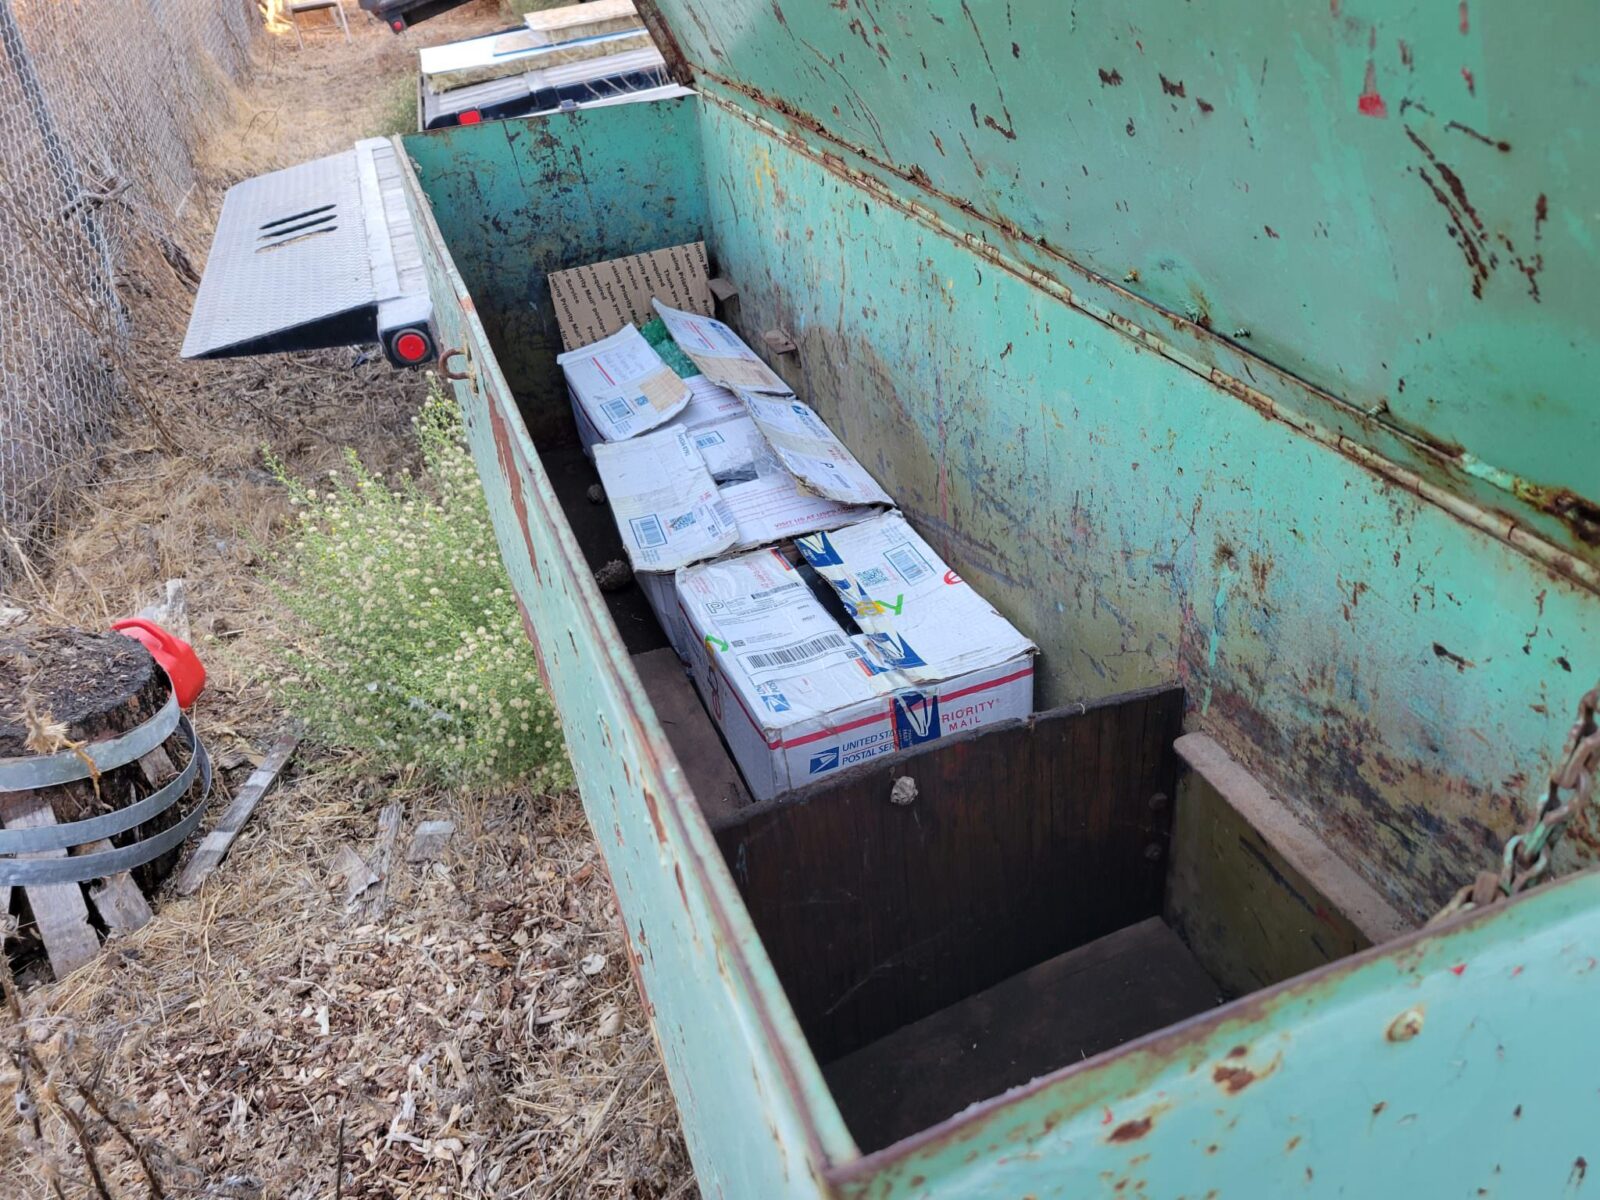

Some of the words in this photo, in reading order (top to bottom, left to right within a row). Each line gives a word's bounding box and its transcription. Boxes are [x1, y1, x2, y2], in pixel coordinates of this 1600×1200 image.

[694, 243, 704, 263] riority
[941, 700, 995, 724] RIORITY
[948, 716, 982, 732] MAIL
[842, 735, 878, 752] UNITED
[878, 729, 896, 742] STA
[841, 750, 877, 766] POSTAL
